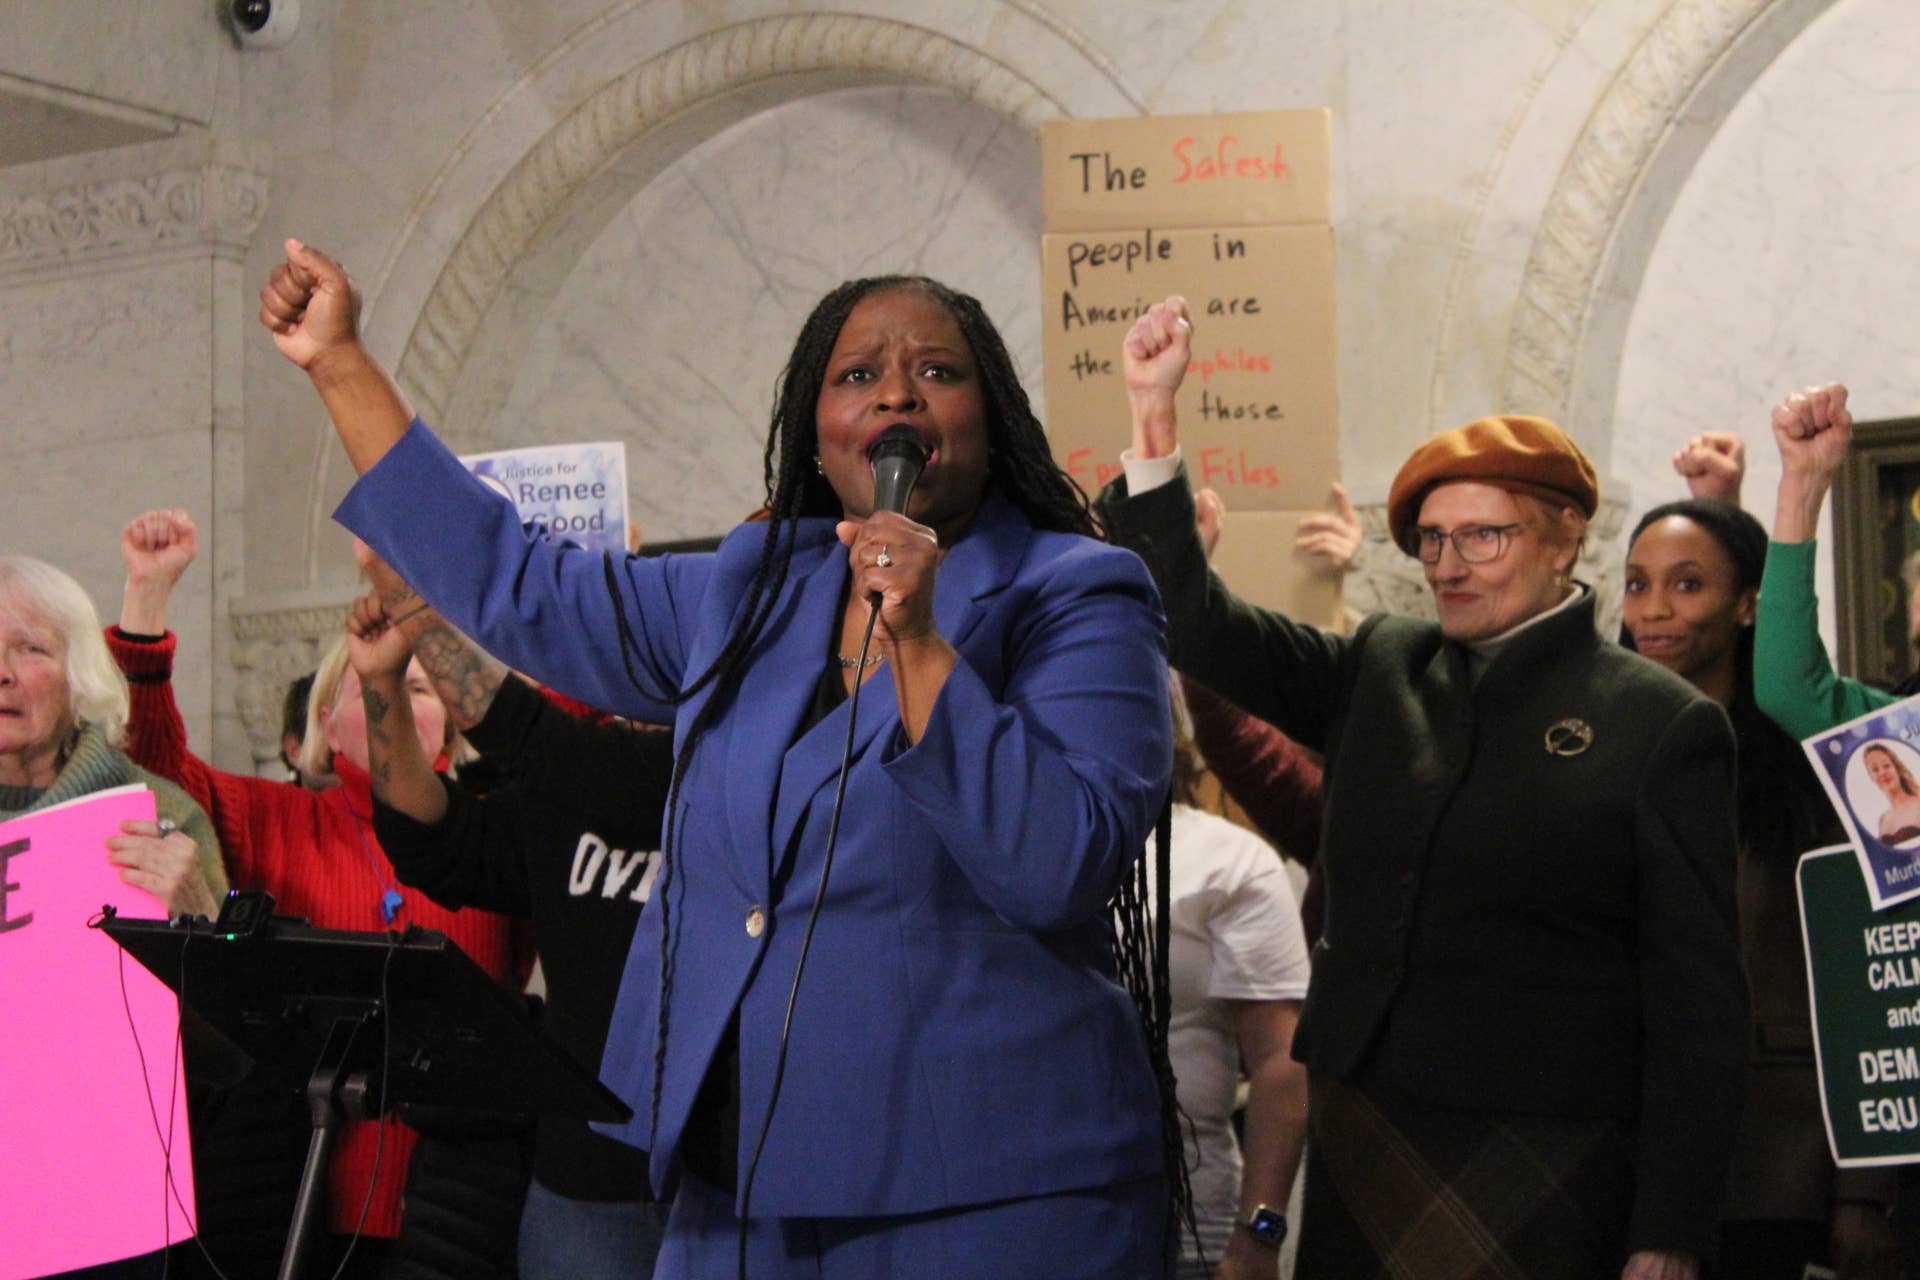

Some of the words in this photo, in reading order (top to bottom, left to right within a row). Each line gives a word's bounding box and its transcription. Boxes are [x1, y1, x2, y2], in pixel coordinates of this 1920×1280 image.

[1069, 151, 1147, 193] The
[1172, 135, 1290, 184] Safest
[1067, 228, 1172, 287] people
[1213, 233, 1246, 261] in
[1062, 291, 1150, 331] Ameri
[1207, 297, 1261, 316] are
[1069, 352, 1113, 381] the
[1187, 347, 1272, 382] ophiles
[1199, 390, 1285, 421] those
[505, 463, 554, 480] Justice
[556, 463, 578, 474] for
[1200, 448, 1281, 488] Files
[519, 481, 606, 504] Renee
[1863, 921, 1920, 956] KEEP
[1859, 1096, 1920, 1132] EQU
